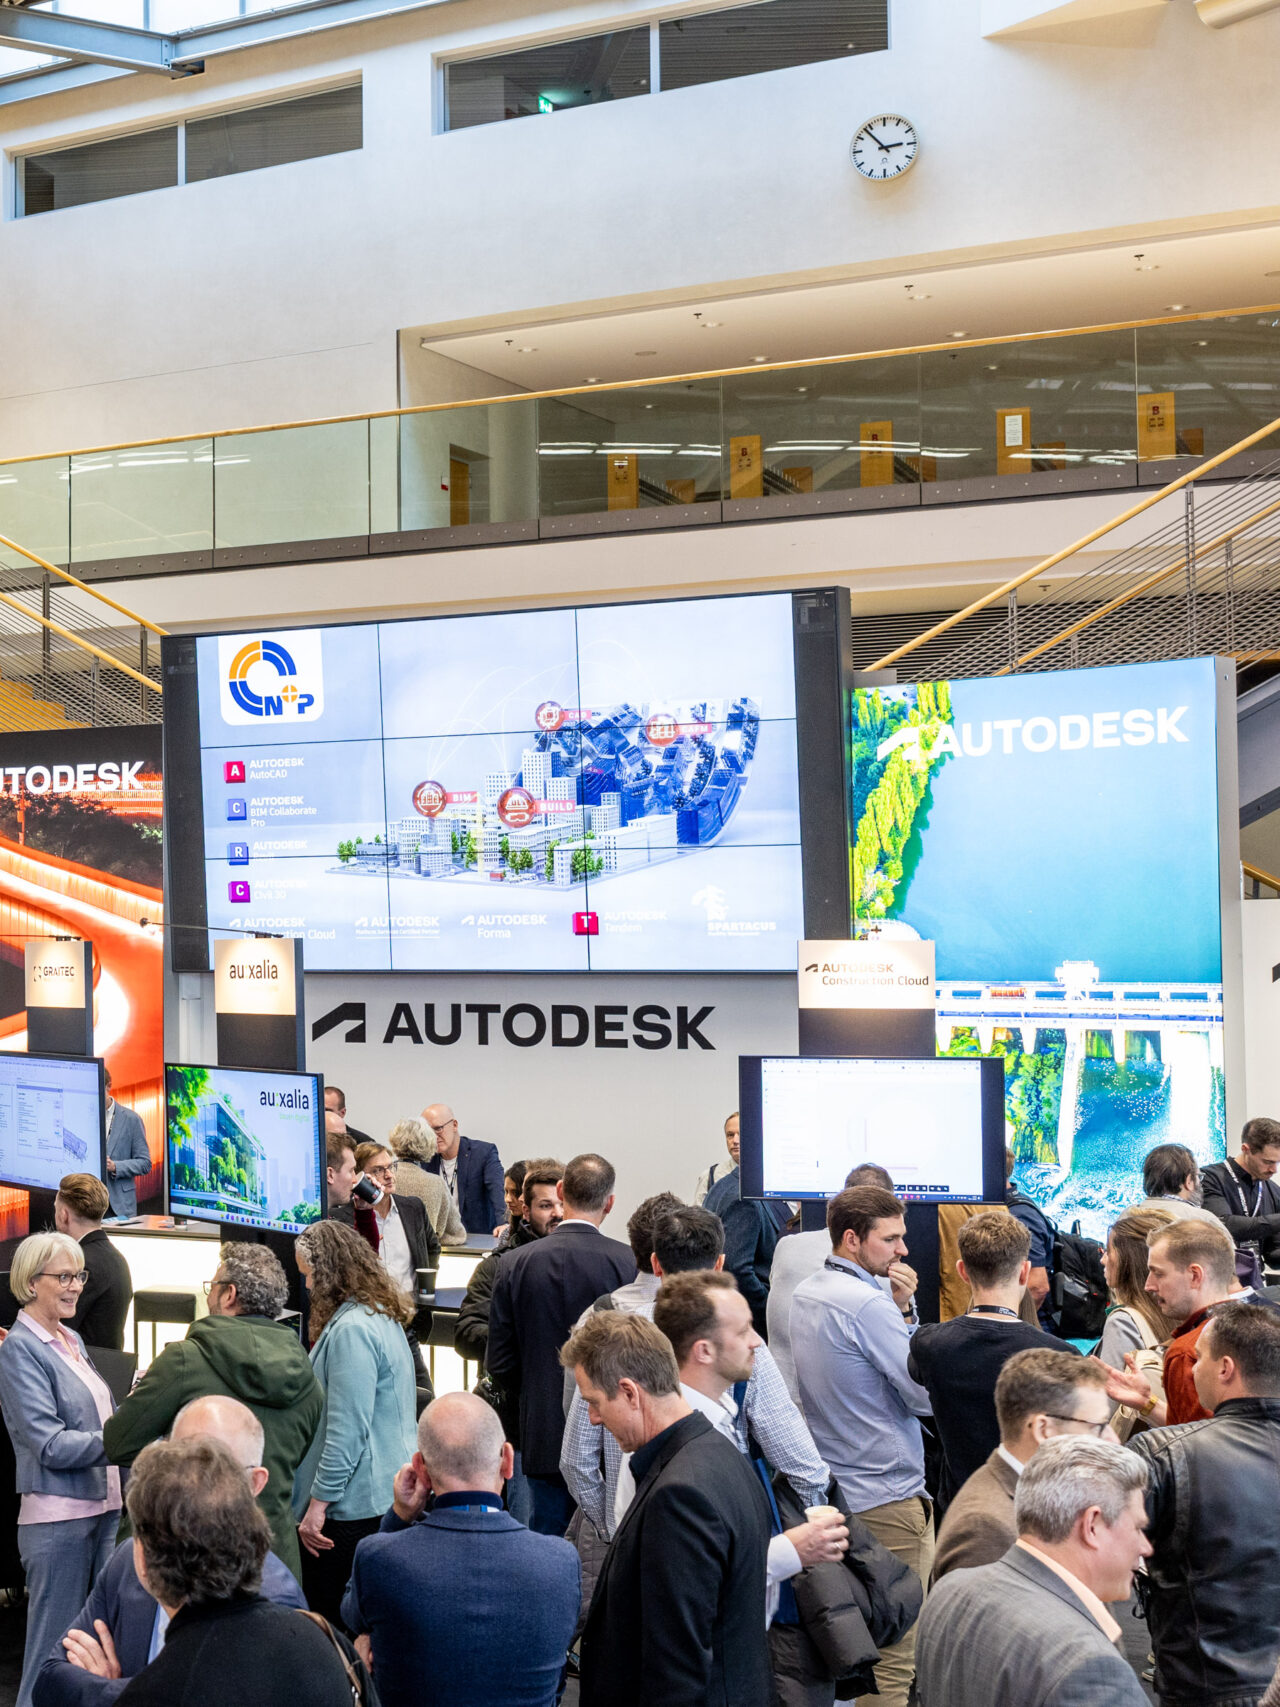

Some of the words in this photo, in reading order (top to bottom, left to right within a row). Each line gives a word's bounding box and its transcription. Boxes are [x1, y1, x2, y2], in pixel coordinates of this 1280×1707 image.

[930, 706, 1190, 759] AUTODESK
[249, 757, 305, 769] AUTODESK
[230, 764, 241, 777] A
[250, 769, 288, 780] AutoCAD
[250, 795, 305, 806] AUTODESK
[232, 802, 241, 814] C
[250, 806, 268, 817] BIM
[269, 805, 318, 817] Collaborate
[540, 802, 573, 812] BUILD
[250, 818, 266, 828] Pro
[253, 840, 308, 851] AUTODESK
[234, 846, 244, 858] R
[235, 884, 245, 896] C
[243, 917, 306, 928] AUTODESK
[370, 915, 440, 927] AUTODESK
[477, 914, 548, 926] AUTODESK
[707, 921, 777, 931] SPARTACUS
[308, 929, 336, 940] Cloud
[477, 927, 511, 939] Forma
[821, 963, 894, 973] AUTODESK
[822, 976, 894, 986] Construction
[898, 976, 930, 986] Cloud
[382, 1002, 717, 1050] AUTODESK
